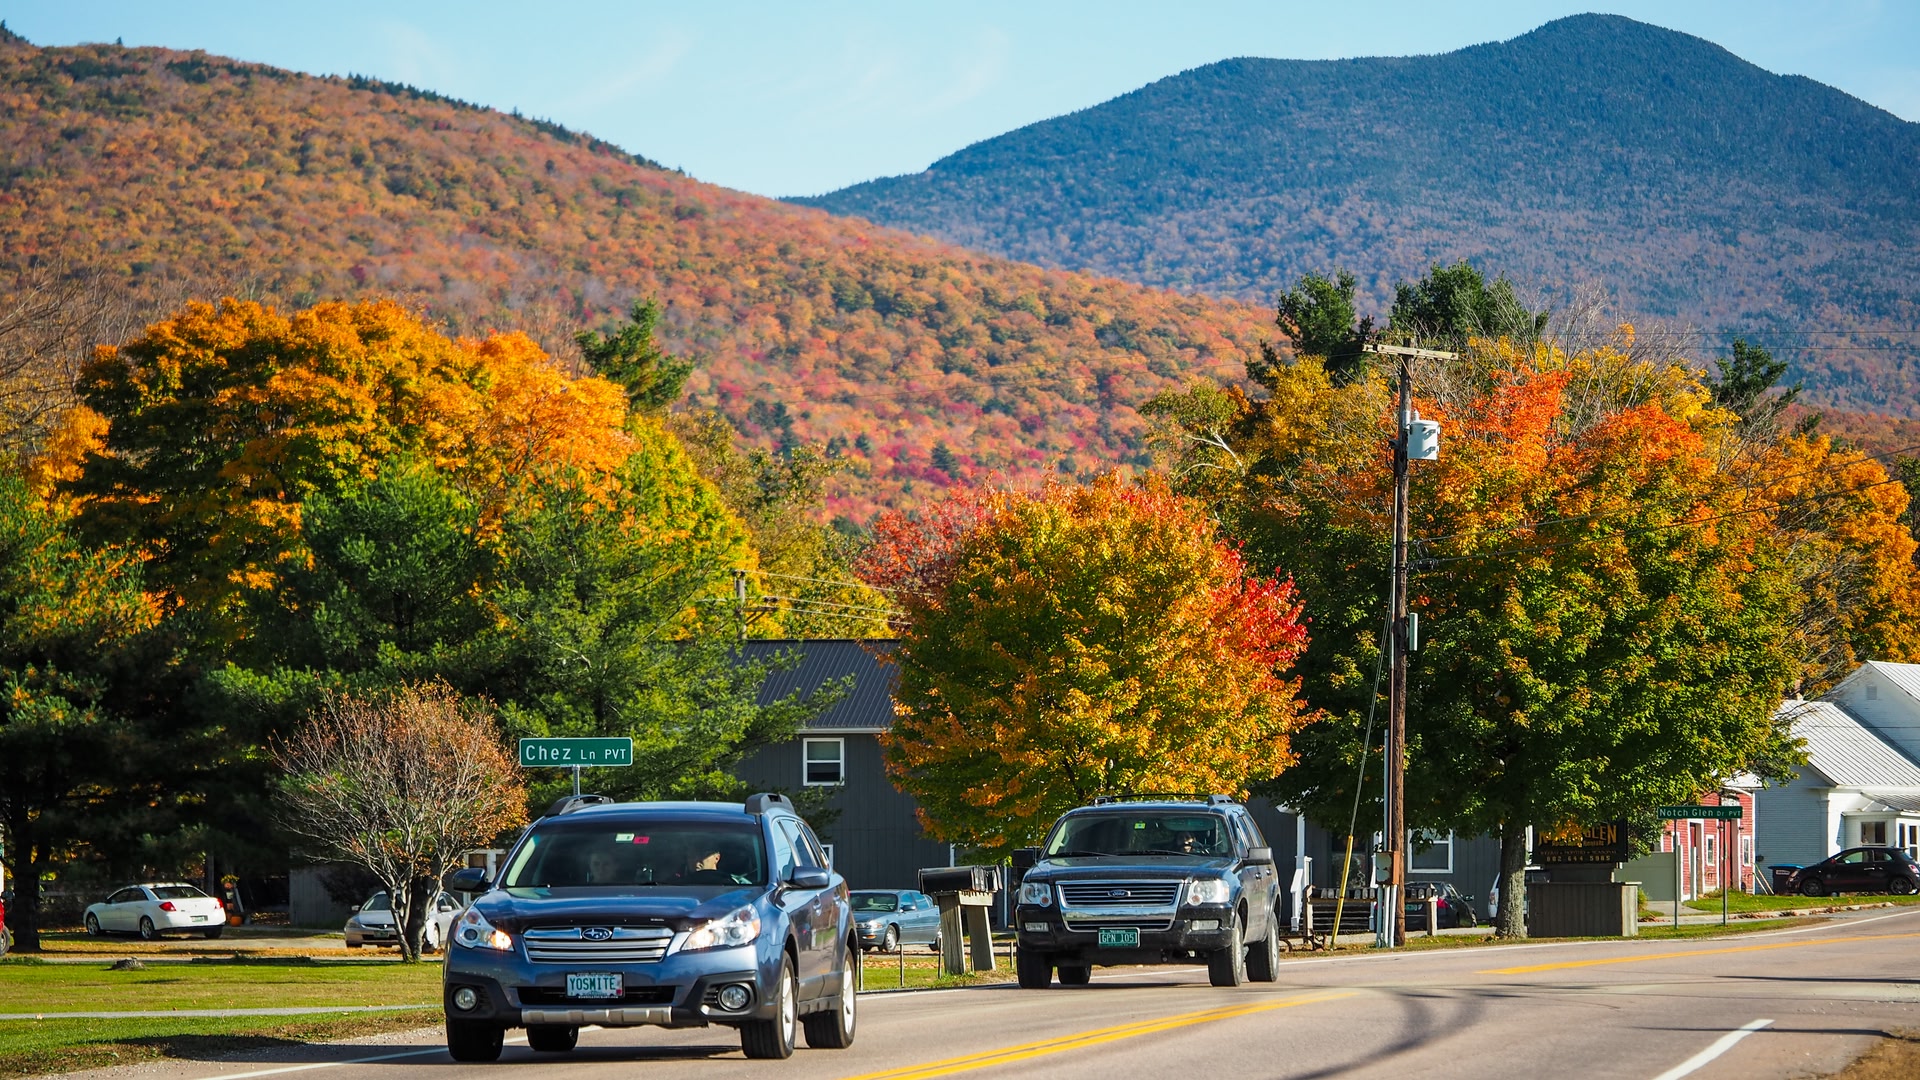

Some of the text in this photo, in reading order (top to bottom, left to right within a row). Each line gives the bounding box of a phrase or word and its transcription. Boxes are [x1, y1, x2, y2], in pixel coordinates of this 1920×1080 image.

[525, 745, 626, 760] Chez Ln PVT
[1659, 809, 1688, 817] Notch
[1691, 809, 1713, 817] Glen
[1101, 933, 1116, 943] GPN
[570, 977, 616, 990] YOSMITE
